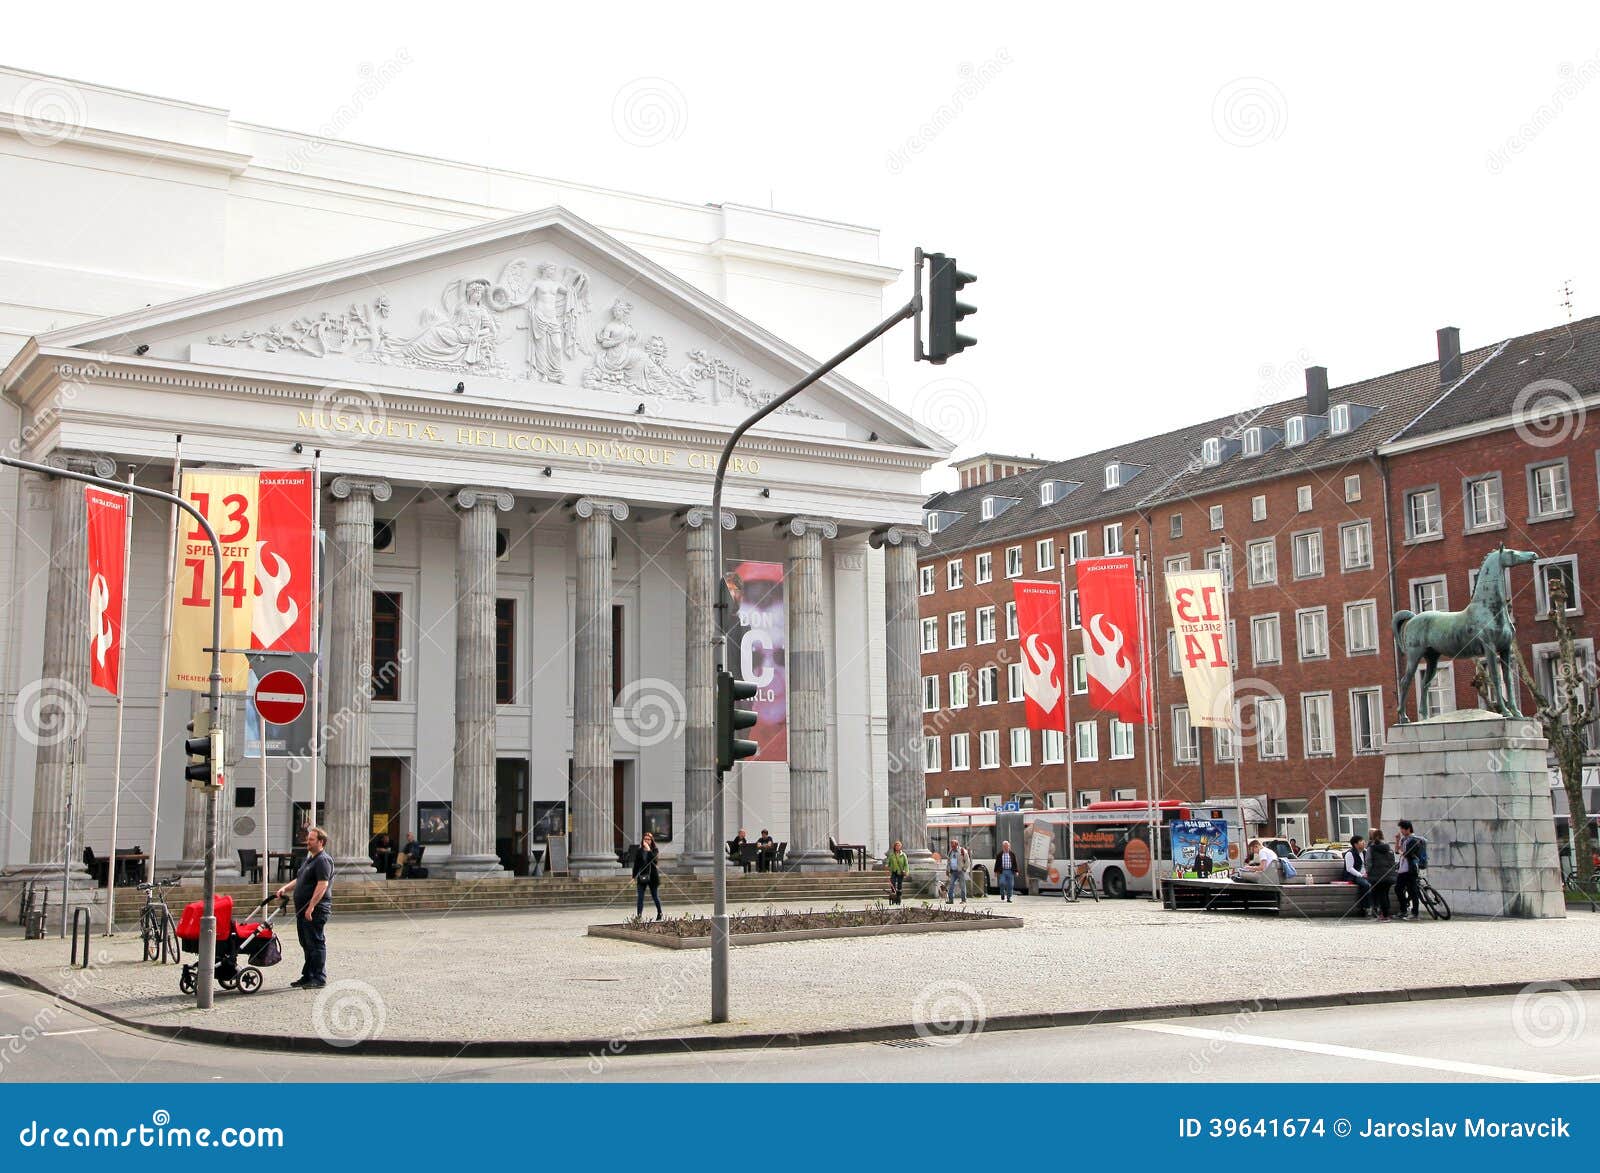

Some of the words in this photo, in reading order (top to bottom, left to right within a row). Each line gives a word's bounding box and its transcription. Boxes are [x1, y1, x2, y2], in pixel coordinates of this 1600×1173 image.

[297, 411, 444, 442] MUSAGETÆ
[456, 428, 676, 465] HELICONIADUMQUE
[187, 492, 250, 543] 13
[186, 544, 249, 558] SPIEZEIT
[182, 559, 247, 608] 14
[176, 674, 233, 683] THEATERAEN
[740, 689, 775, 702] RLO
